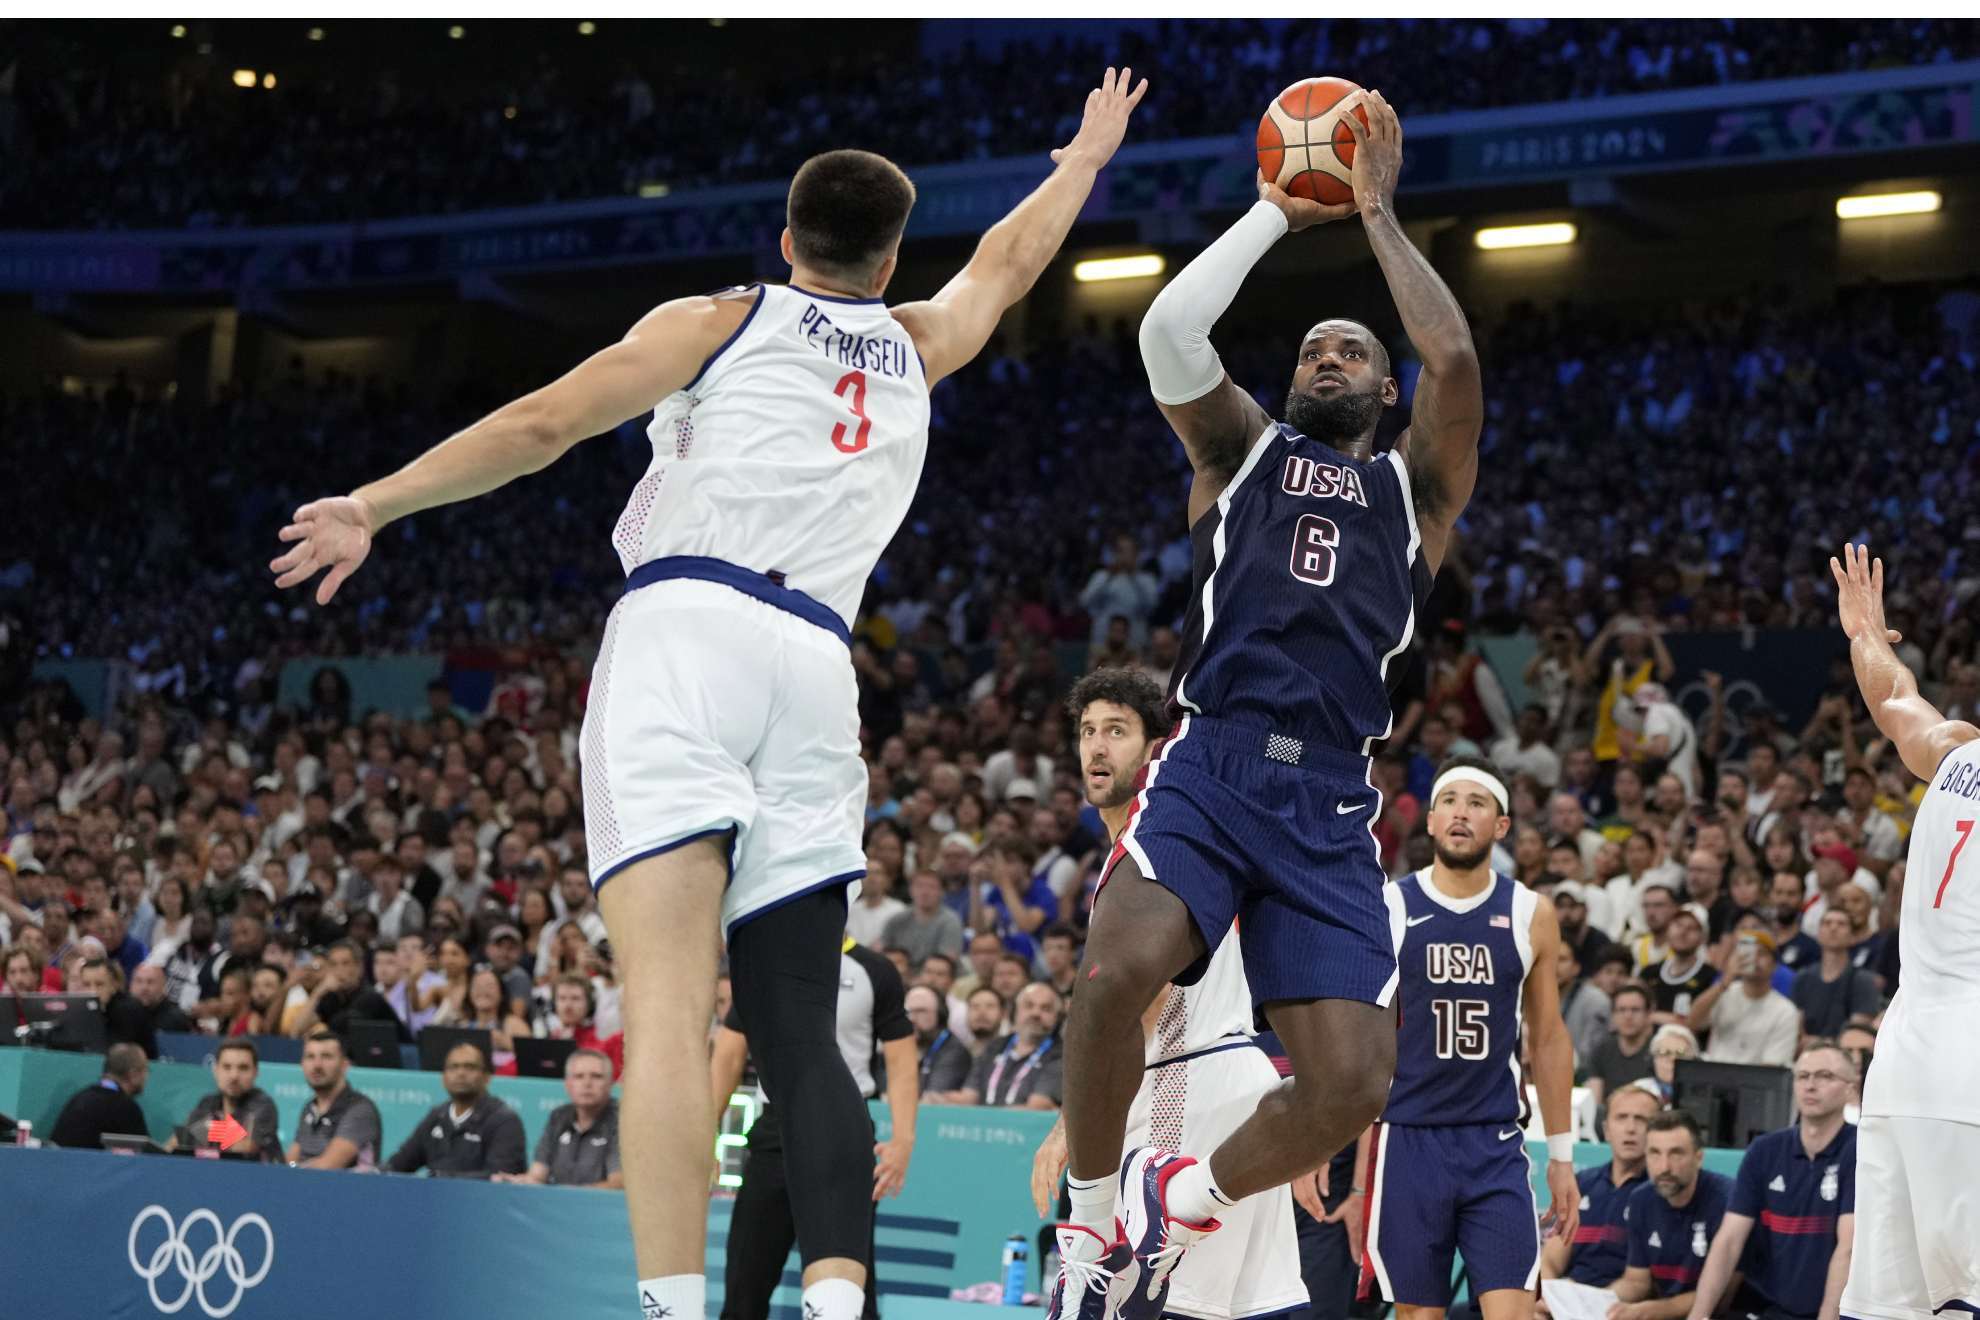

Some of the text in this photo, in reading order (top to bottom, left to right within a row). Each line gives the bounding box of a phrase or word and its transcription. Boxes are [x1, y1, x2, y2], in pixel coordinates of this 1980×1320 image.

[1481, 126, 1667, 168] PARIS 2024
[831, 370, 873, 453] 3
[1281, 455, 1369, 508] USA
[1289, 513, 1340, 587] 6
[1933, 820, 1975, 909] 7
[1426, 943, 1495, 985] USA
[1431, 999, 1490, 1060] 15
